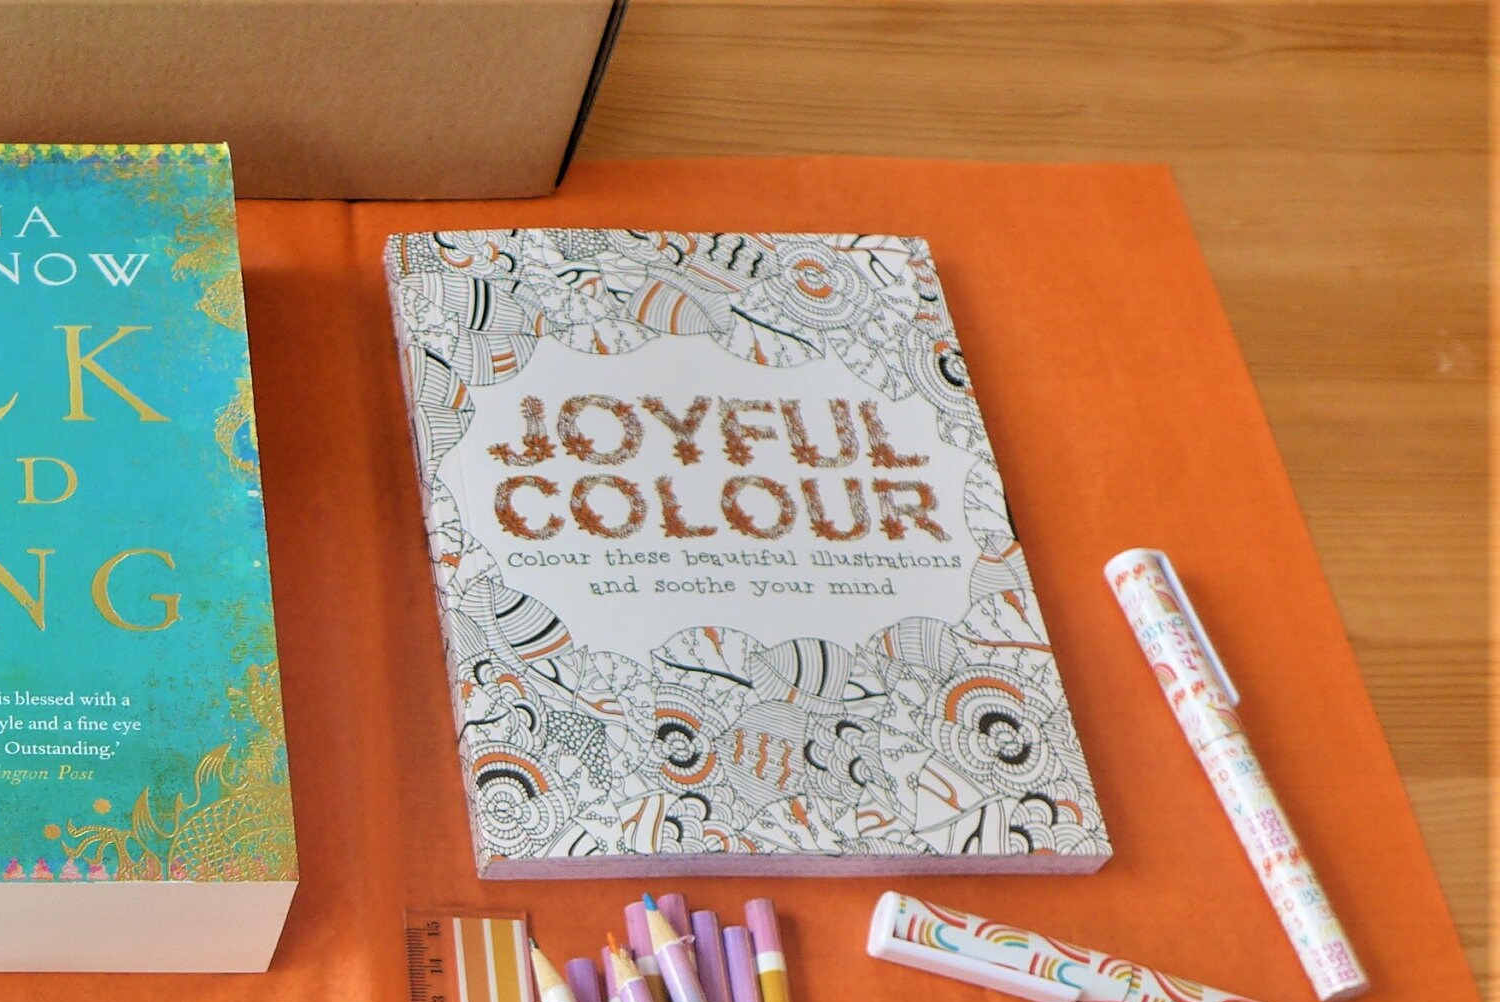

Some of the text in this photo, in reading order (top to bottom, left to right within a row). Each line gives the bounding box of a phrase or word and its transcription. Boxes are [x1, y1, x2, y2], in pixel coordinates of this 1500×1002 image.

[487, 393, 930, 469] JOYFUL
[493, 473, 952, 543] COLOUR
[508, 549, 962, 570] Colour these beautiful illustrations
[589, 577, 896, 598] and soothe your mind
[14, 690, 74, 707] blessed
[79, 690, 117, 707] with
[121, 696, 131, 707] a
[28, 716, 60, 732] and
[64, 721, 73, 732] a
[77, 715, 109, 732] fine
[112, 720, 142, 738] eye
[57, 764, 95, 781] Post
[427, 921, 441, 937] 15
[430, 958, 444, 975] 14
